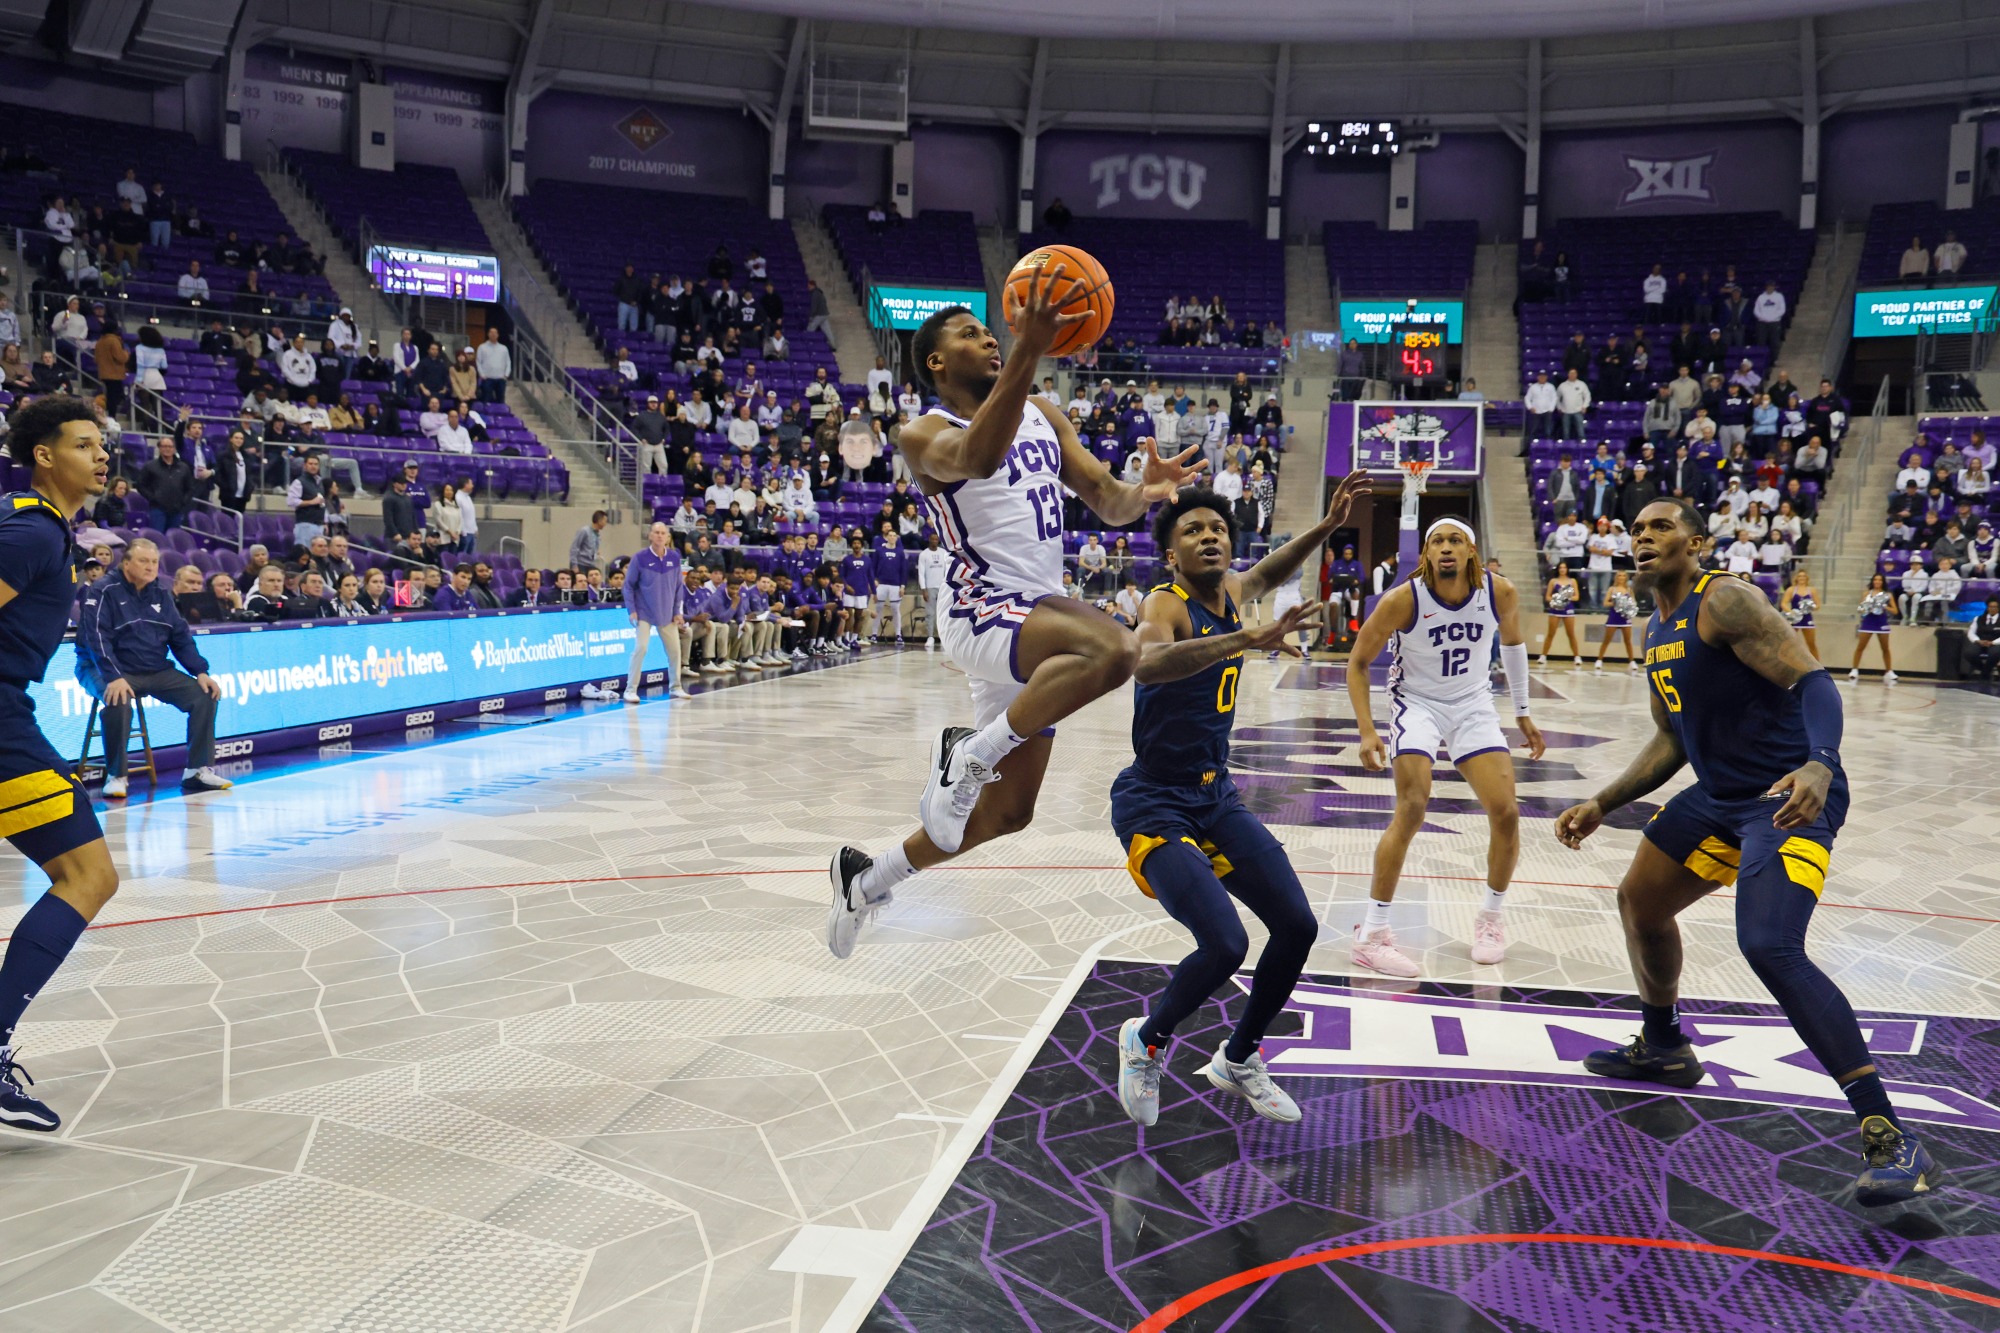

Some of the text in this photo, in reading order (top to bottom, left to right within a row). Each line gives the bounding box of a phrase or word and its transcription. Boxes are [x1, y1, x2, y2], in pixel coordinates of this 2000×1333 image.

[280, 66, 349, 87] MEN'S NIT
[243, 86, 348, 112] 83 1992 1996
[393, 81, 482, 105] APPEARANCES
[393, 106, 422, 121] 1997
[433, 112, 463, 127] 1999
[630, 125, 658, 136] NIT
[1321, 132, 1329, 143] 0
[1341, 122, 1370, 137] 18:54
[1386, 131, 1394, 142] 0
[589, 155, 697, 178] 2017 CHAMPIONS
[1089, 153, 1207, 211] TCU
[1625, 154, 1713, 202] XII
[407, 252, 420, 263] OF
[421, 253, 446, 266] TOWN
[446, 257, 479, 269] SCORES
[882, 297, 914, 310] PROUD
[1871, 298, 1985, 314] PROUD PARTNER OF
[891, 309, 912, 321] TCU
[1354, 312, 1447, 323] PROUD PARNER OF
[1881, 314, 1907, 326] TCU
[1363, 323, 1384, 334] TCU
[1404, 331, 1441, 348] 18:54
[1209, 420, 1216, 432] 7
[999, 439, 1060, 487] TCU
[1027, 483, 1061, 541] 13
[589, 631, 600, 643] ALL
[600, 629, 620, 642] SAINTS
[620, 628, 637, 640] MEDIC
[1428, 622, 1484, 647] TCU
[589, 643, 625, 657] FORT WORTH
[1656, 640, 1685, 663] VIRGINIA
[1440, 648, 1471, 677] 12
[235, 668, 276, 704] you
[362, 646, 406, 688] right
[406, 646, 449, 677] here.
[646, 672, 664, 684] GEICO
[601, 679, 620, 691] GEICO
[1216, 666, 1239, 713] 0
[1652, 668, 1682, 713] 15
[545, 688, 567, 701] GEICO
[479, 698, 505, 712] GEICO
[406, 711, 435, 727] GEICO
[319, 723, 353, 741] GEICO
[214, 740, 254, 759] GEICO
[206, 748, 653, 858] WALSH FAMILY COURT
